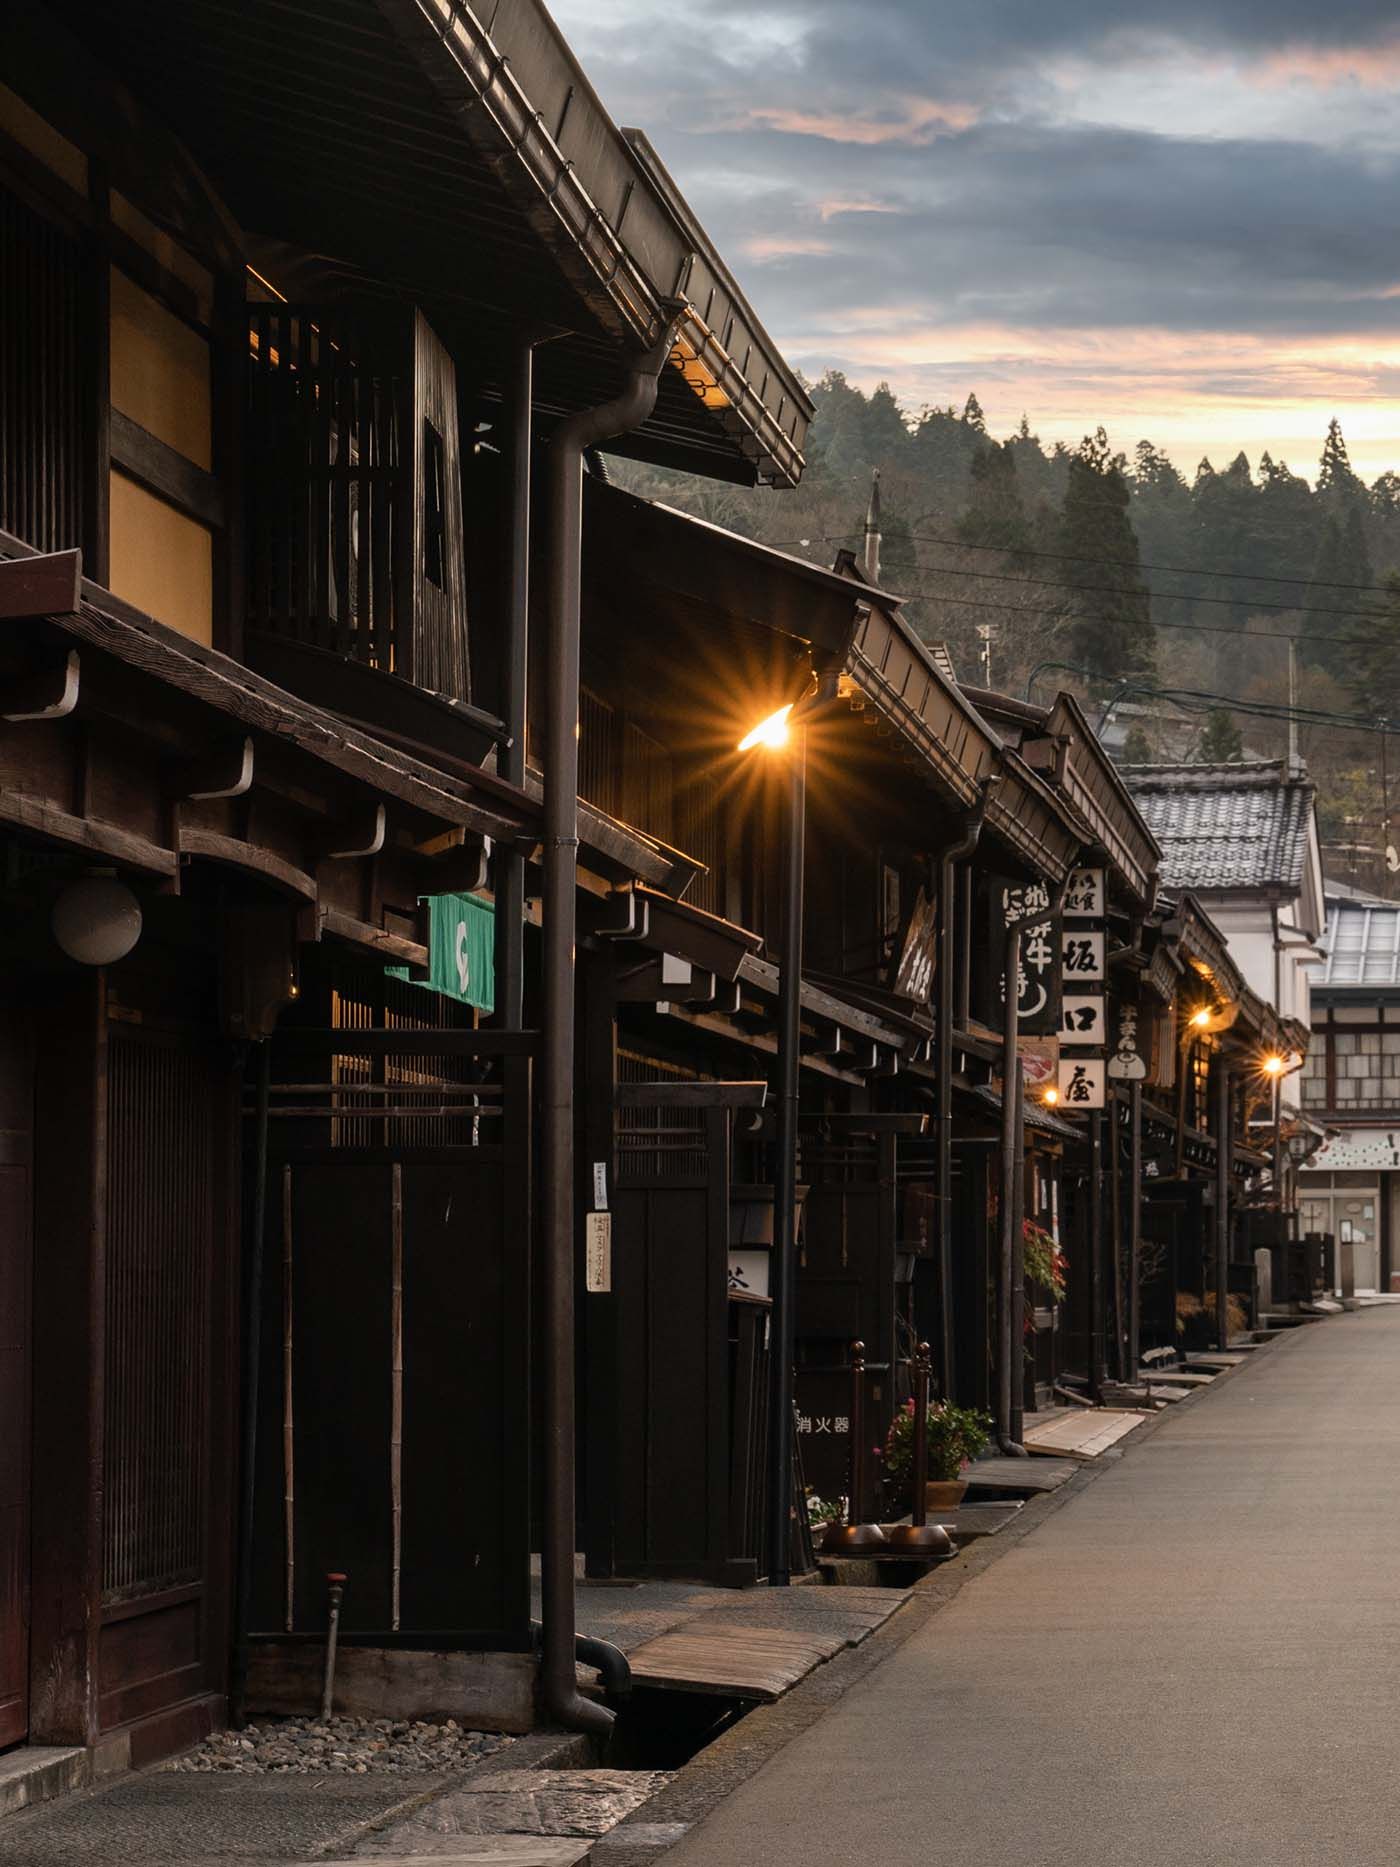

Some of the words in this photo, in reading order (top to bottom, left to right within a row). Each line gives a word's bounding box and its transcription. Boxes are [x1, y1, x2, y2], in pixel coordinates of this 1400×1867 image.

[1063, 940, 1098, 1103] 坂口屋
[796, 1417, 849, 1433] 消火器
